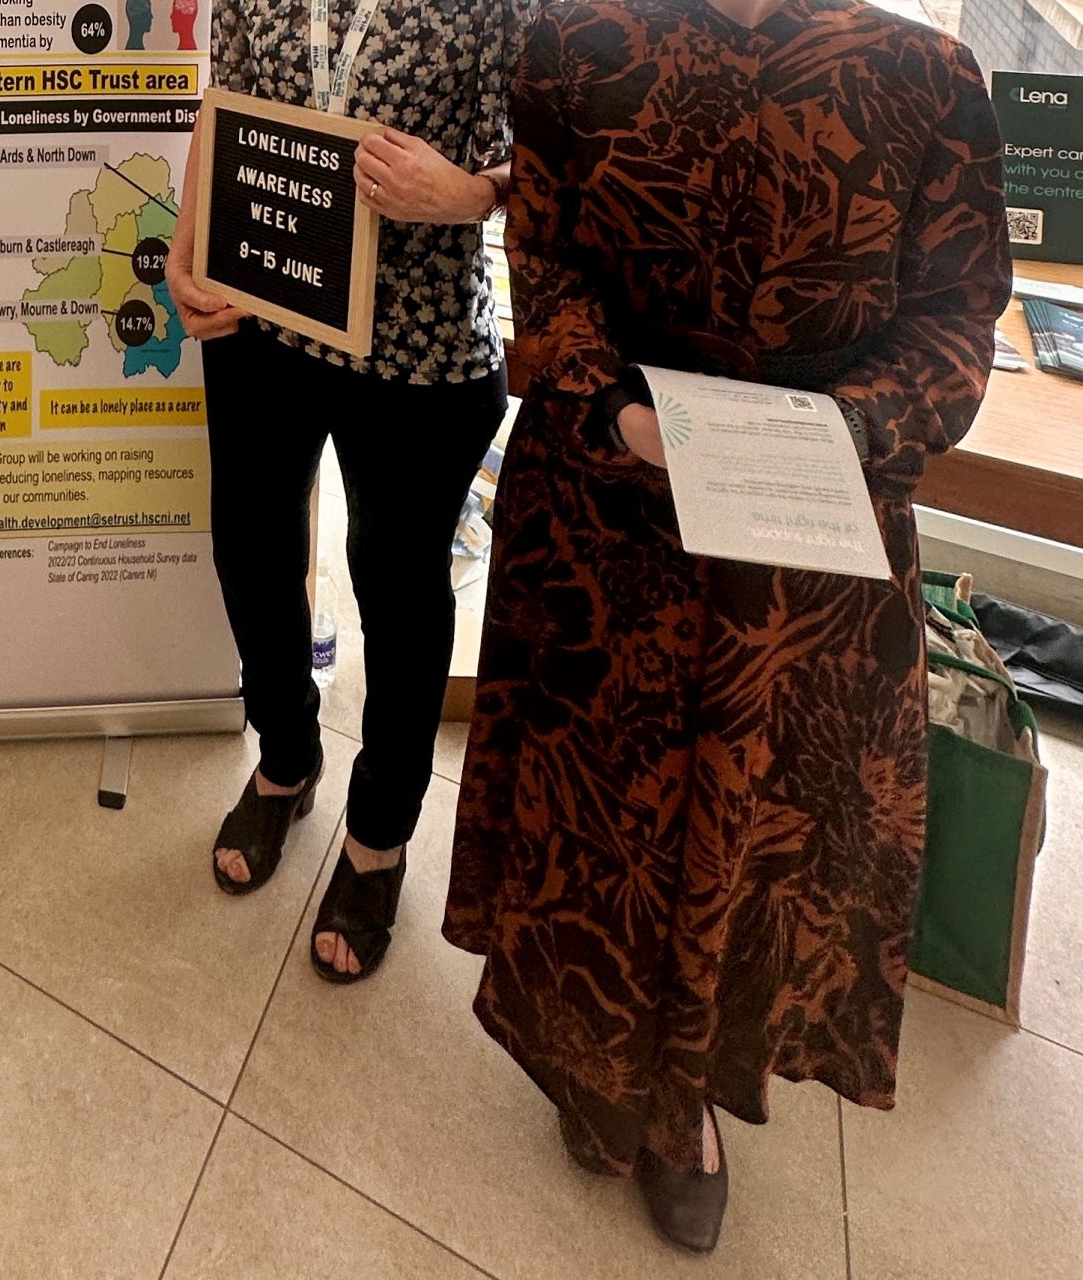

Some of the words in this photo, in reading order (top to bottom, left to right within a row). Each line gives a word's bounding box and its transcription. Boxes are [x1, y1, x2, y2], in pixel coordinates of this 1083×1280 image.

[81, 21, 105, 38] 64%
[42, 69, 82, 91] HSC
[88, 69, 140, 90] Trust
[145, 74, 189, 90] area
[1020, 86, 1068, 105] Lena
[0, 110, 70, 125] Loneliness
[73, 109, 89, 127] by
[92, 108, 172, 123] Government
[0, 148, 24, 164] Ards
[26, 147, 35, 163] &
[36, 147, 65, 163] North
[67, 147, 96, 162] Down
[238, 127, 340, 171] LONELINESS
[1004, 143, 1054, 159] Expert
[1004, 163, 1036, 176] with
[1040, 167, 1070, 179] you
[237, 165, 333, 209] AWARENESS
[1003, 181, 1030, 195] the
[250, 202, 297, 234] WEEK
[25, 238, 33, 254] &
[35, 237, 95, 256] Castlereagh
[282, 258, 323, 287] JUNE
[20, 301, 58, 317] Mourne
[60, 300, 68, 315] &
[70, 300, 99, 317] Down
[120, 316, 153, 332] 14.7%
[47, 540, 84, 554] Campaign
[84, 539, 92, 551] to
[92, 538, 108, 550] End
[108, 537, 146, 550] Loneliness
